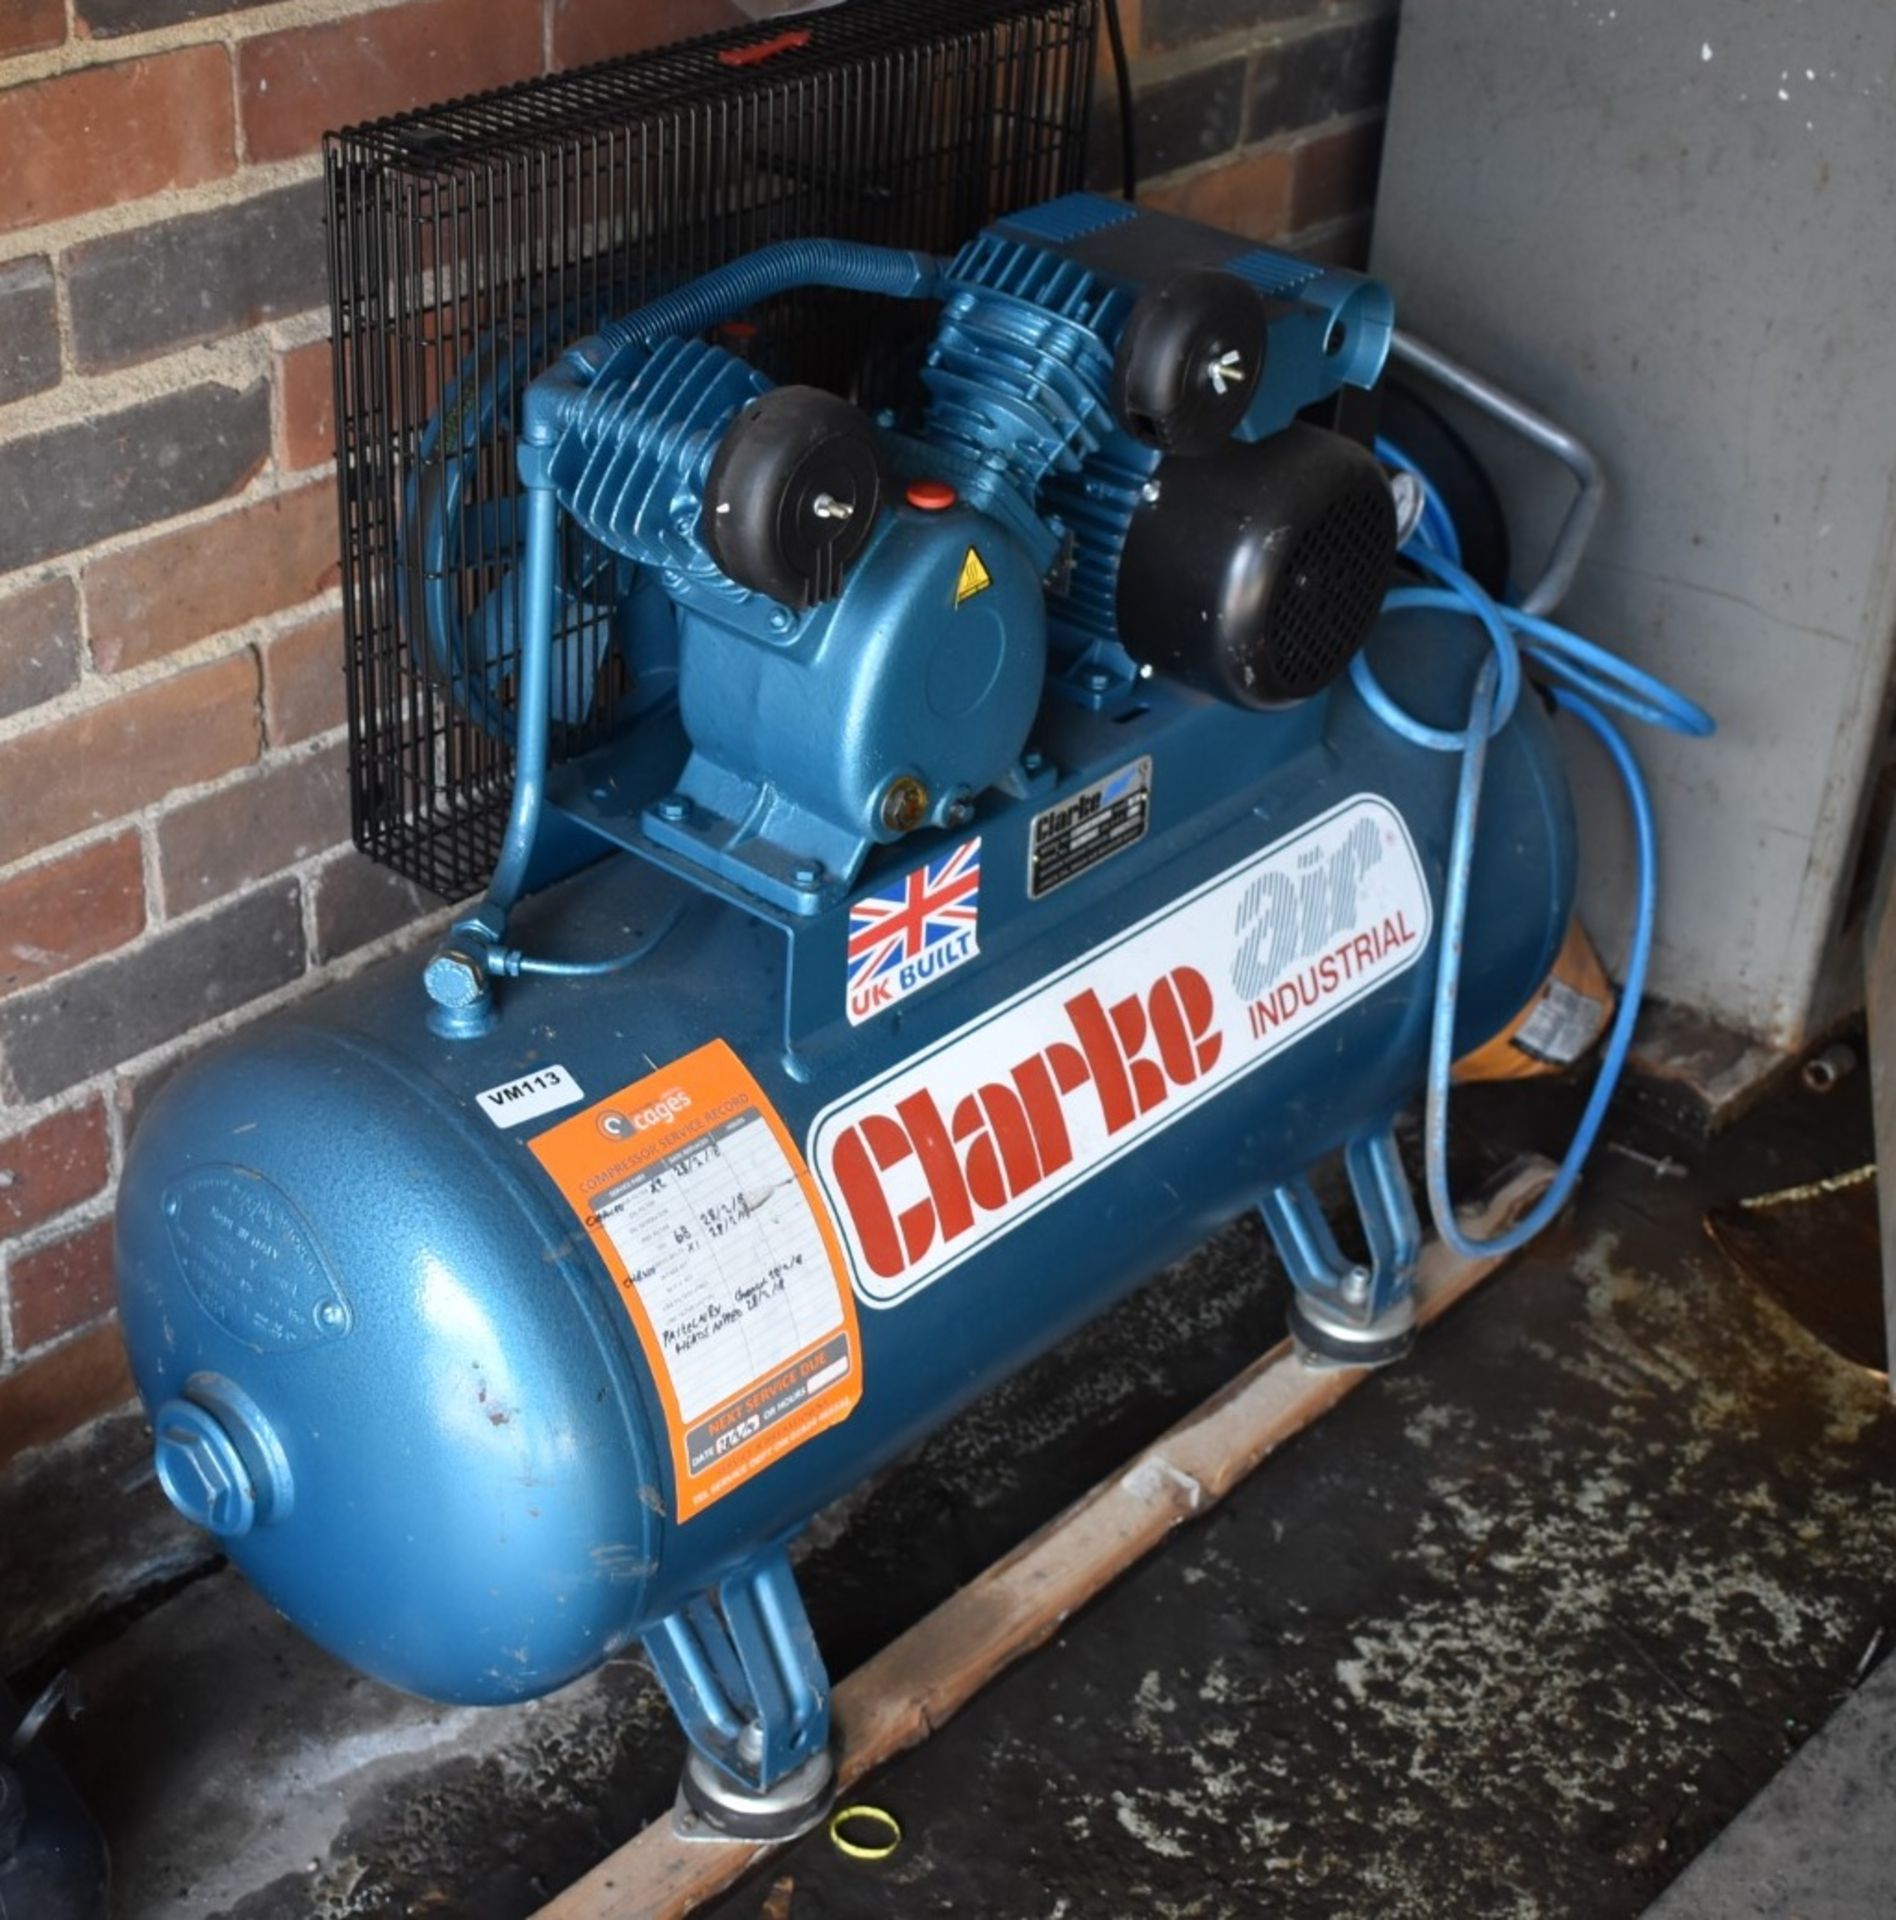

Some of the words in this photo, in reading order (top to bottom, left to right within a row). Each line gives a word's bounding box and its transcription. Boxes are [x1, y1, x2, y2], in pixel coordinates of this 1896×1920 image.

[1037, 791, 1101, 844] Clarke
[1231, 816, 1383, 1001] air
[852, 977, 893, 1016] UK
[899, 931, 971, 991] BUILT
[1248, 909, 1416, 1040] INDUSTRIAL
[487, 1071, 561, 1106] VM113
[633, 1090, 693, 1131] cages
[832, 965, 1223, 1279] Clarke
[580, 1146, 657, 1194] COMPRESSOR
[658, 1119, 704, 1149] SERVICE
[704, 1092, 750, 1124] RECORD
[708, 1406, 742, 1436] NEXT
[744, 1372, 798, 1412] SERVICE
[800, 1351, 828, 1378] DUE
[777, 1387, 806, 1411] HOURS
[692, 1446, 714, 1468] DATE
